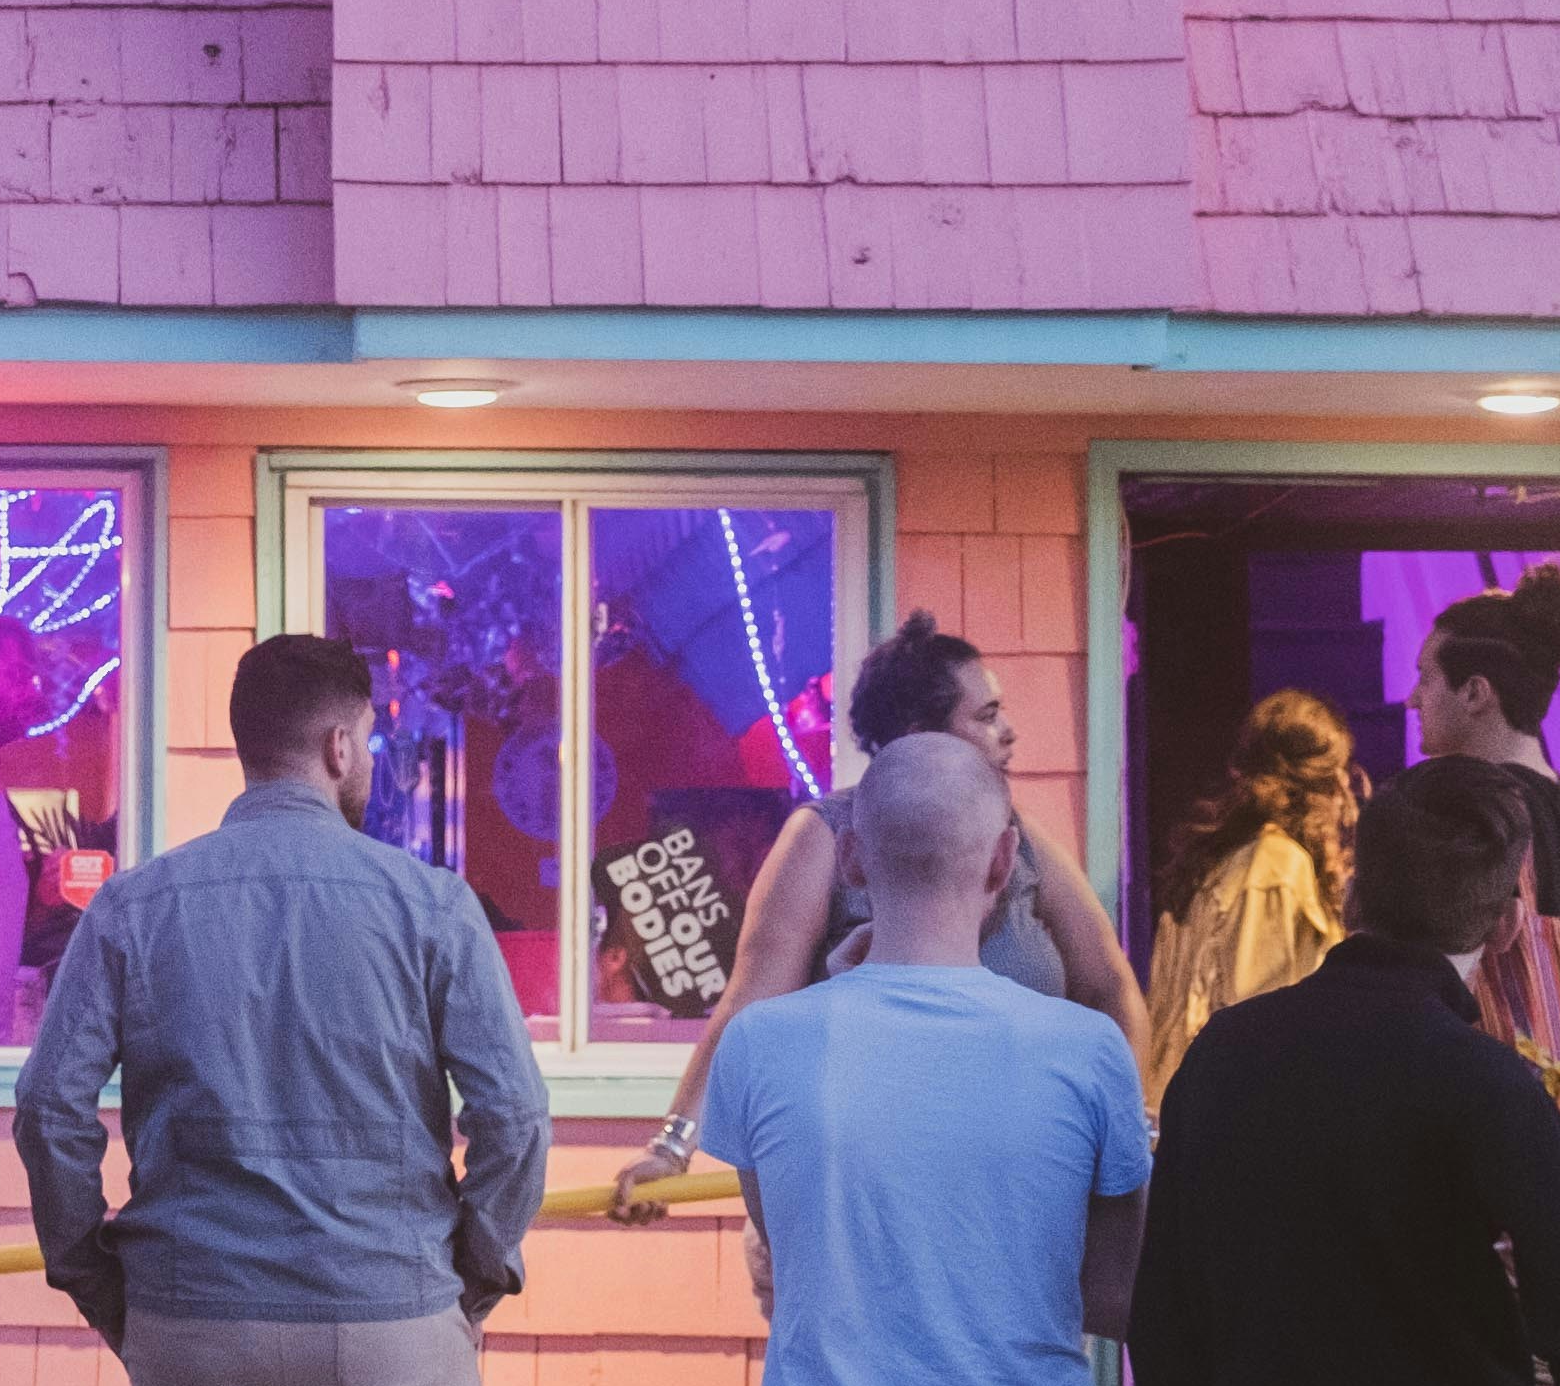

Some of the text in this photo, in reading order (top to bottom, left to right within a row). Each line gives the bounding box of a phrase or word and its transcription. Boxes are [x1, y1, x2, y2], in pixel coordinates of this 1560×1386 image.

[606, 854, 694, 997] BODIES
[636, 841, 727, 1001] OFF OUR
[662, 828, 730, 927] BANS
